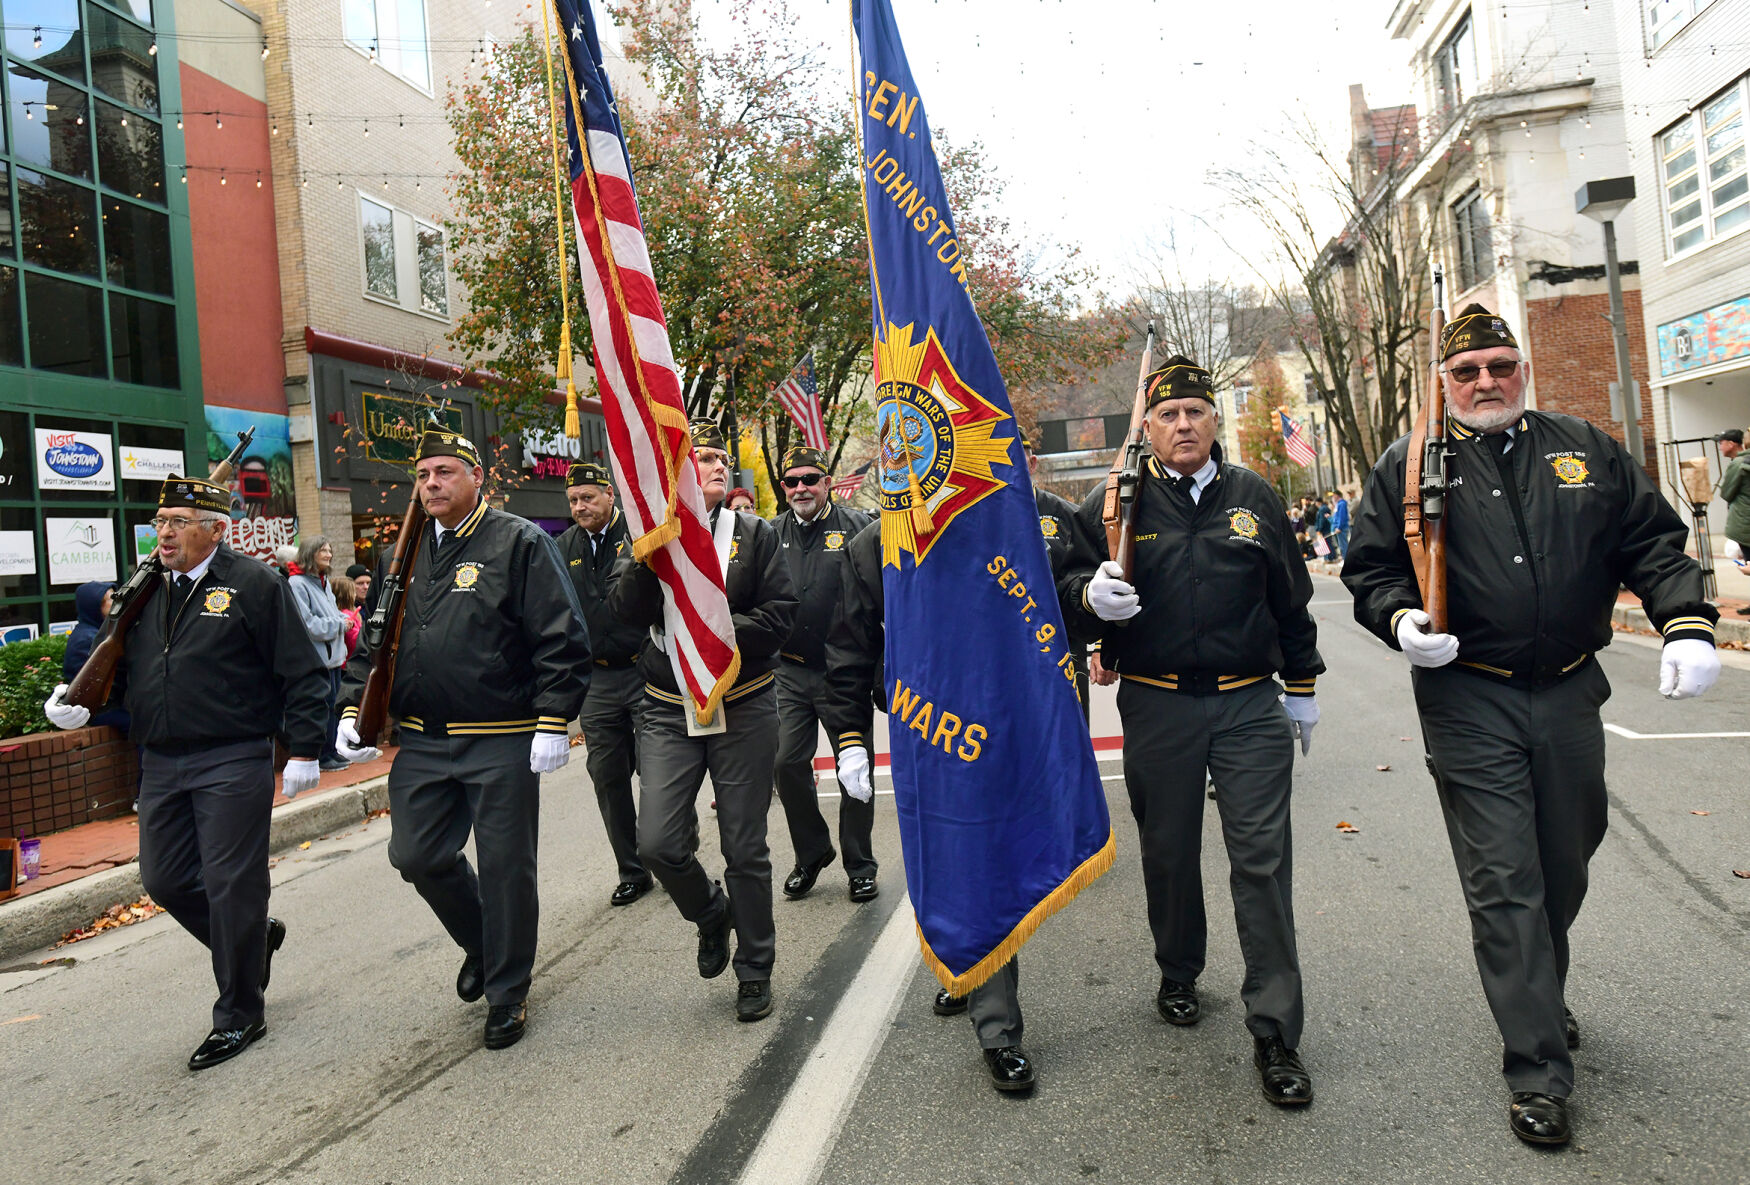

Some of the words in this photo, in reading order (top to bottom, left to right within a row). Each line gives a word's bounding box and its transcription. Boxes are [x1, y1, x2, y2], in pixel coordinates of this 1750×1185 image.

[1455, 333, 1471, 343] VFW
[1456, 342, 1469, 350] 155
[915, 390, 945, 423] WARS
[46, 433, 77, 448] VISIT
[938, 426, 951, 442] OF
[49, 449, 100, 468] JOHNSTOWN
[137, 461, 181, 470] CHALLENGE
[936, 449, 952, 474] THE
[1449, 476, 1463, 488] HN
[51, 551, 114, 565] CAMBRIA
[987, 555, 1037, 623] SEPT.
[1035, 623, 1056, 653] 9,
[1057, 651, 1082, 703] 19
[890, 678, 988, 763] WARS
